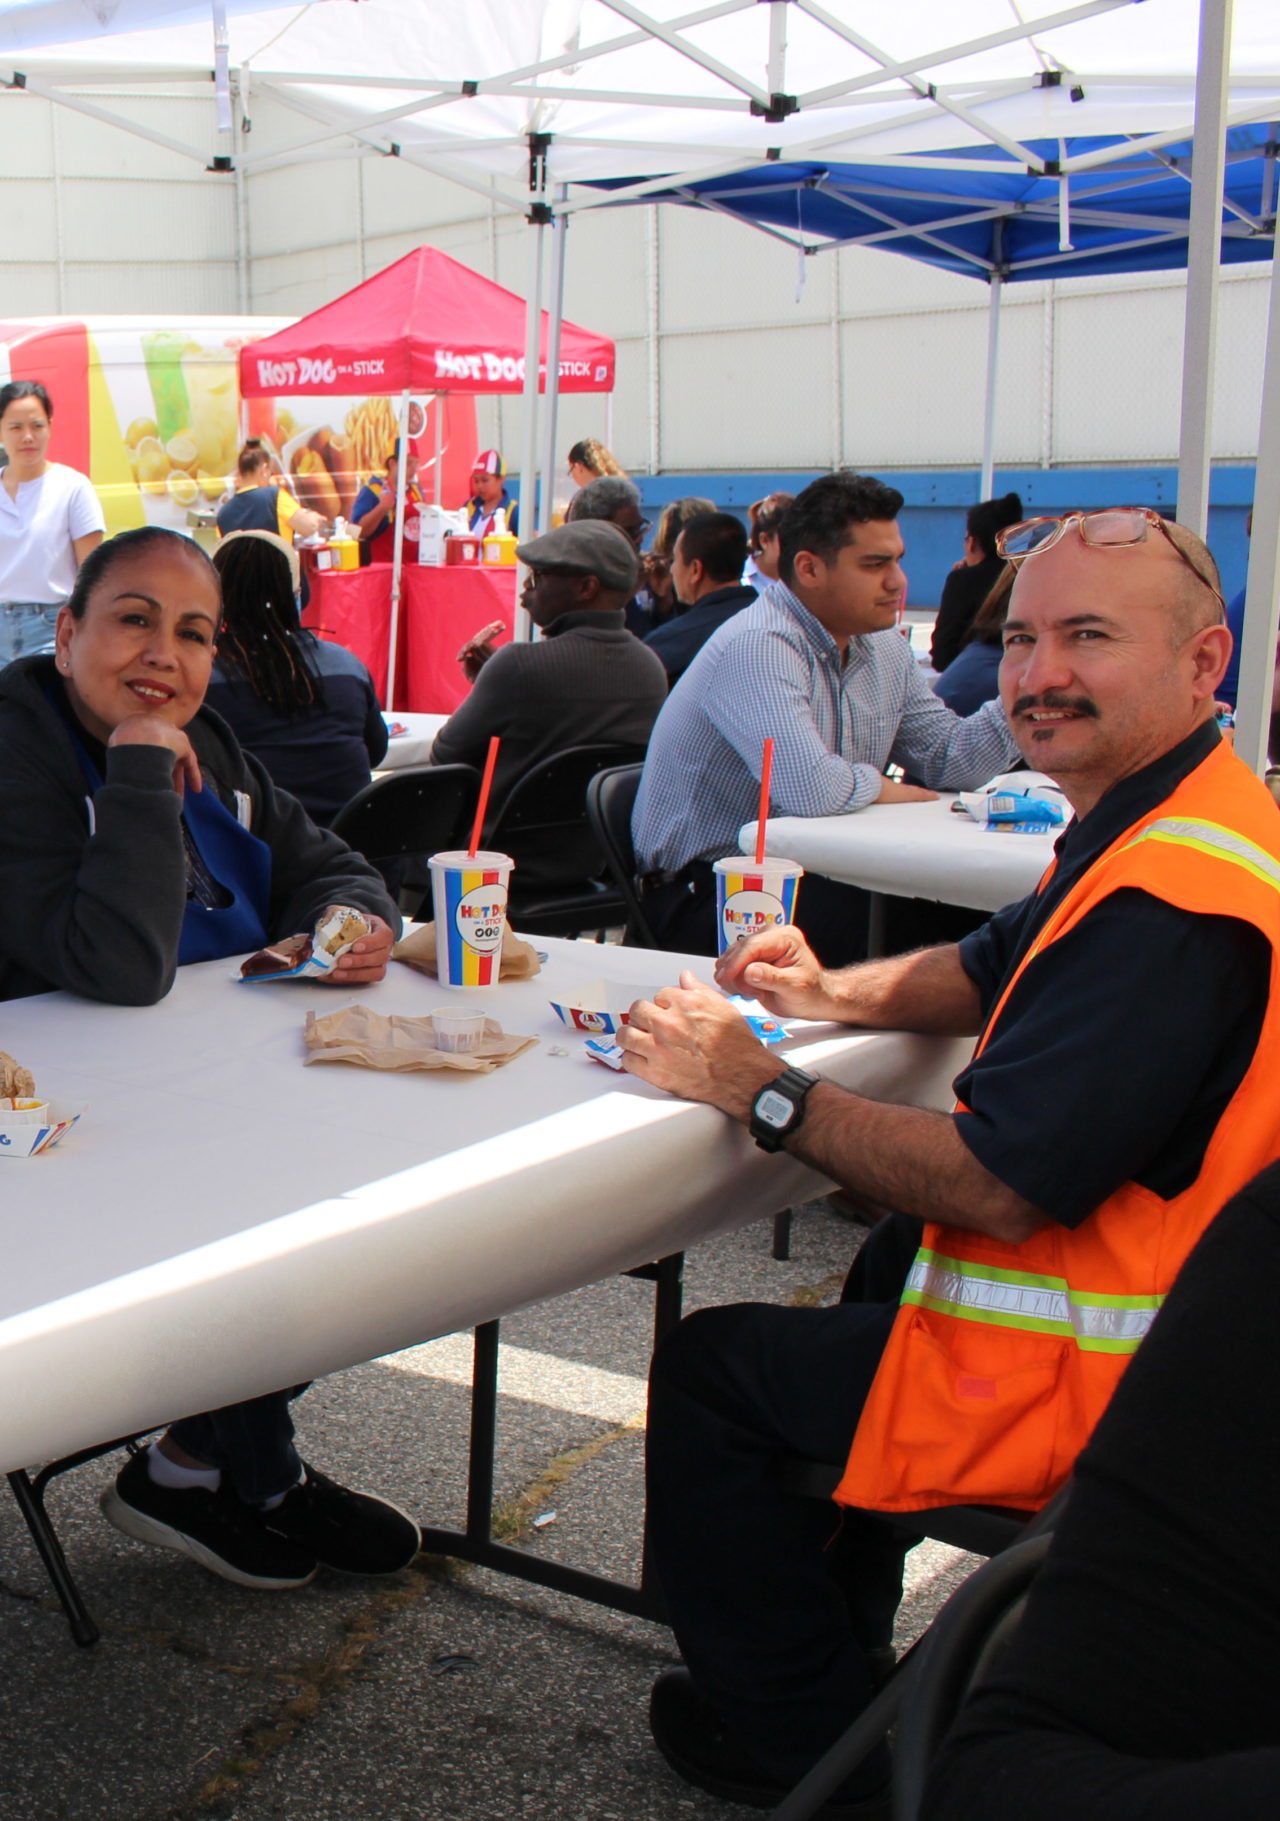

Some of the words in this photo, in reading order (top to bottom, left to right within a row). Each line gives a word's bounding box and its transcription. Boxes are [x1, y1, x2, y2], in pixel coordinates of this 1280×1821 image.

[257, 359, 297, 388] HOT
[297, 357, 337, 385] DOG
[353, 359, 385, 376] STICK
[434, 350, 482, 380] HOT
[461, 905, 490, 918] HOT
[725, 909, 752, 924] HOT
[755, 912, 783, 925] DOG
